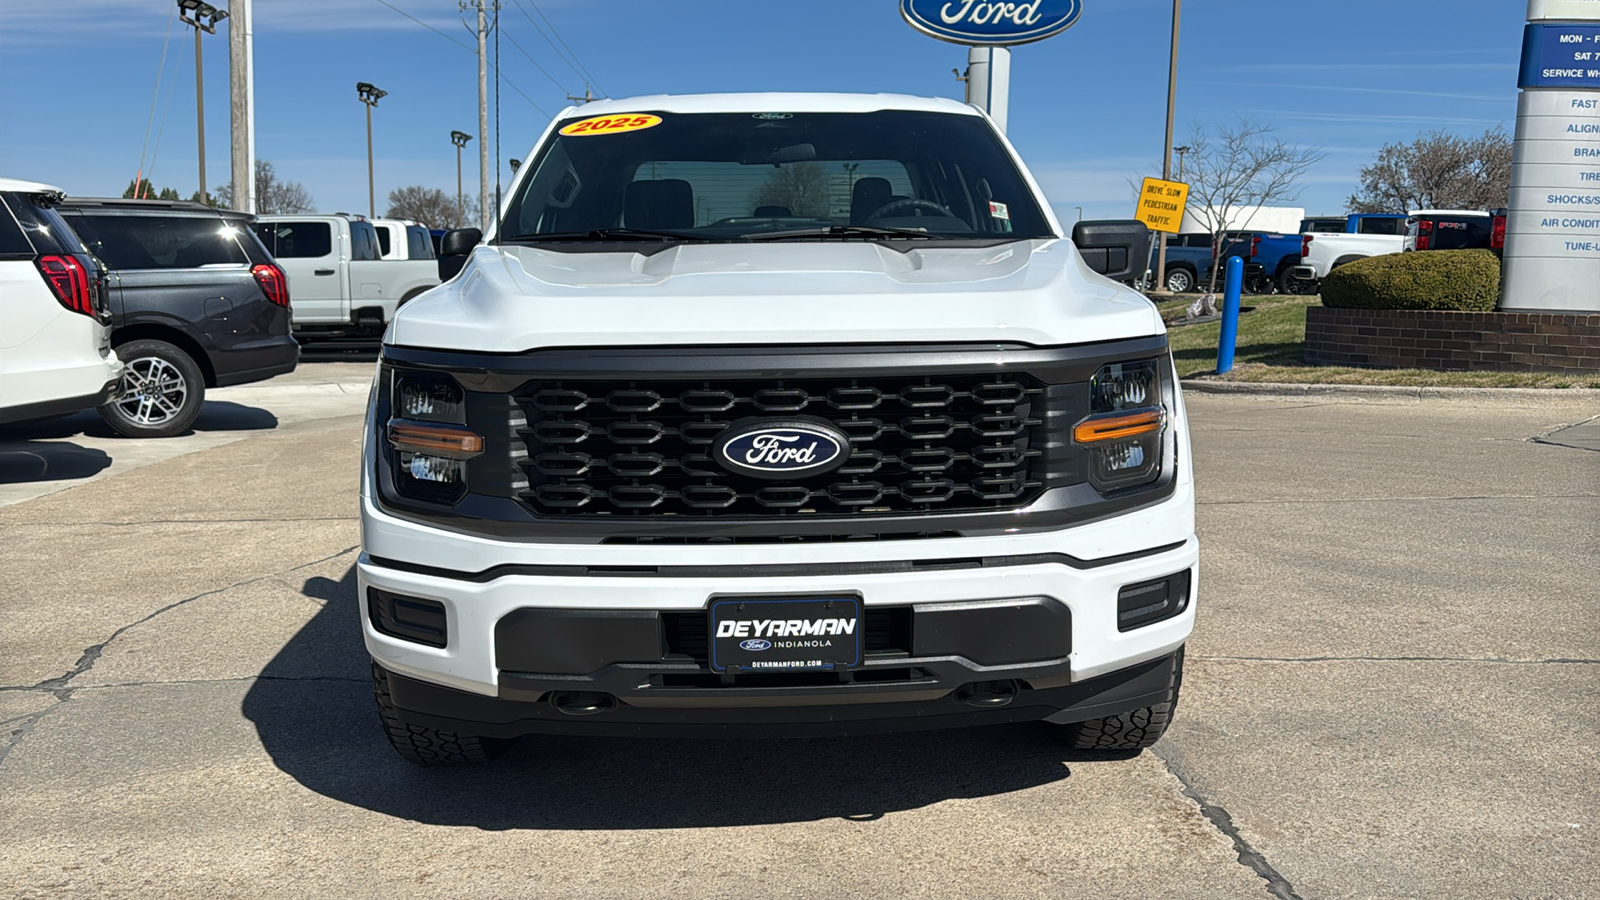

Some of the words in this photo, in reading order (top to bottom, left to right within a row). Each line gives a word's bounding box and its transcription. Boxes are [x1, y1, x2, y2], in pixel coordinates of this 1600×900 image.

[940, 0, 1042, 25] Ford
[1560, 34, 1583, 43] MON
[1574, 51, 1592, 61] SAT
[1542, 68, 1584, 78] SERVICE
[1571, 99, 1598, 108] FAST
[569, 116, 652, 134] 2025
[1567, 123, 1600, 133] ALIGN
[1146, 185, 1164, 196] DRIVE
[1166, 187, 1182, 198] SLOW
[1143, 199, 1178, 212] PEDESTRIAN
[1147, 214, 1171, 226] TRAFFIC
[1541, 218, 1559, 227] AIR
[745, 434, 818, 464] Ford
[715, 618, 857, 638] DEYARMAN
[745, 640, 765, 649] Ford
[774, 640, 832, 649] INDIANOLA
[752, 660, 822, 668] DEYARMANFORD.COM
